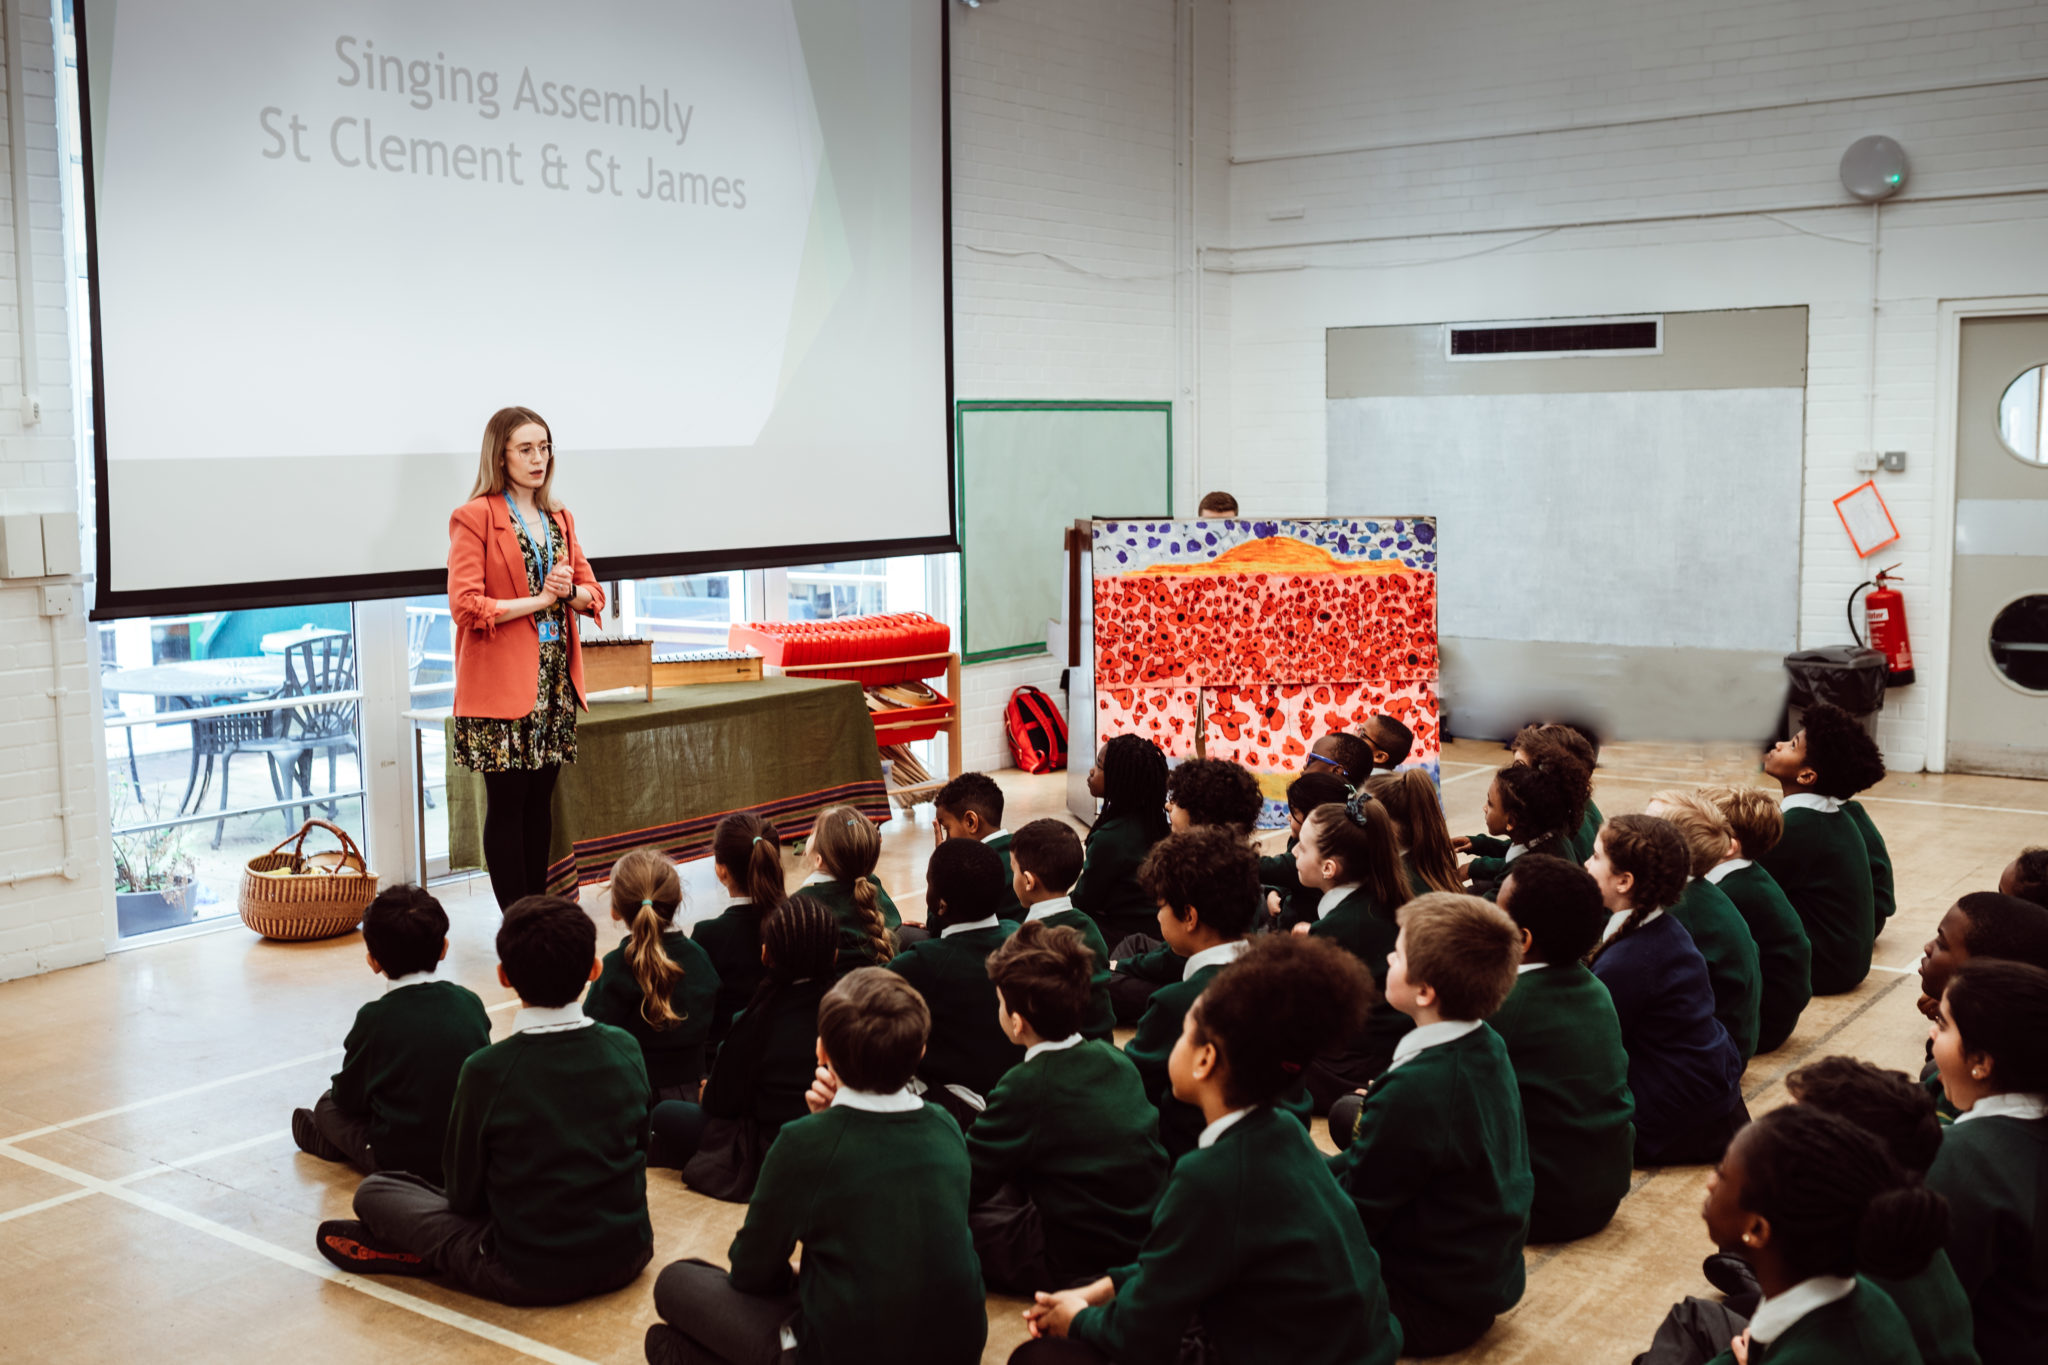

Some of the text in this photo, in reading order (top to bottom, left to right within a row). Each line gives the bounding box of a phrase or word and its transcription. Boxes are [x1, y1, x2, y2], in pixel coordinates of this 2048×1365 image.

[335, 35, 694, 146] Singing Assembly
[259, 106, 747, 210] St Clement & St James
